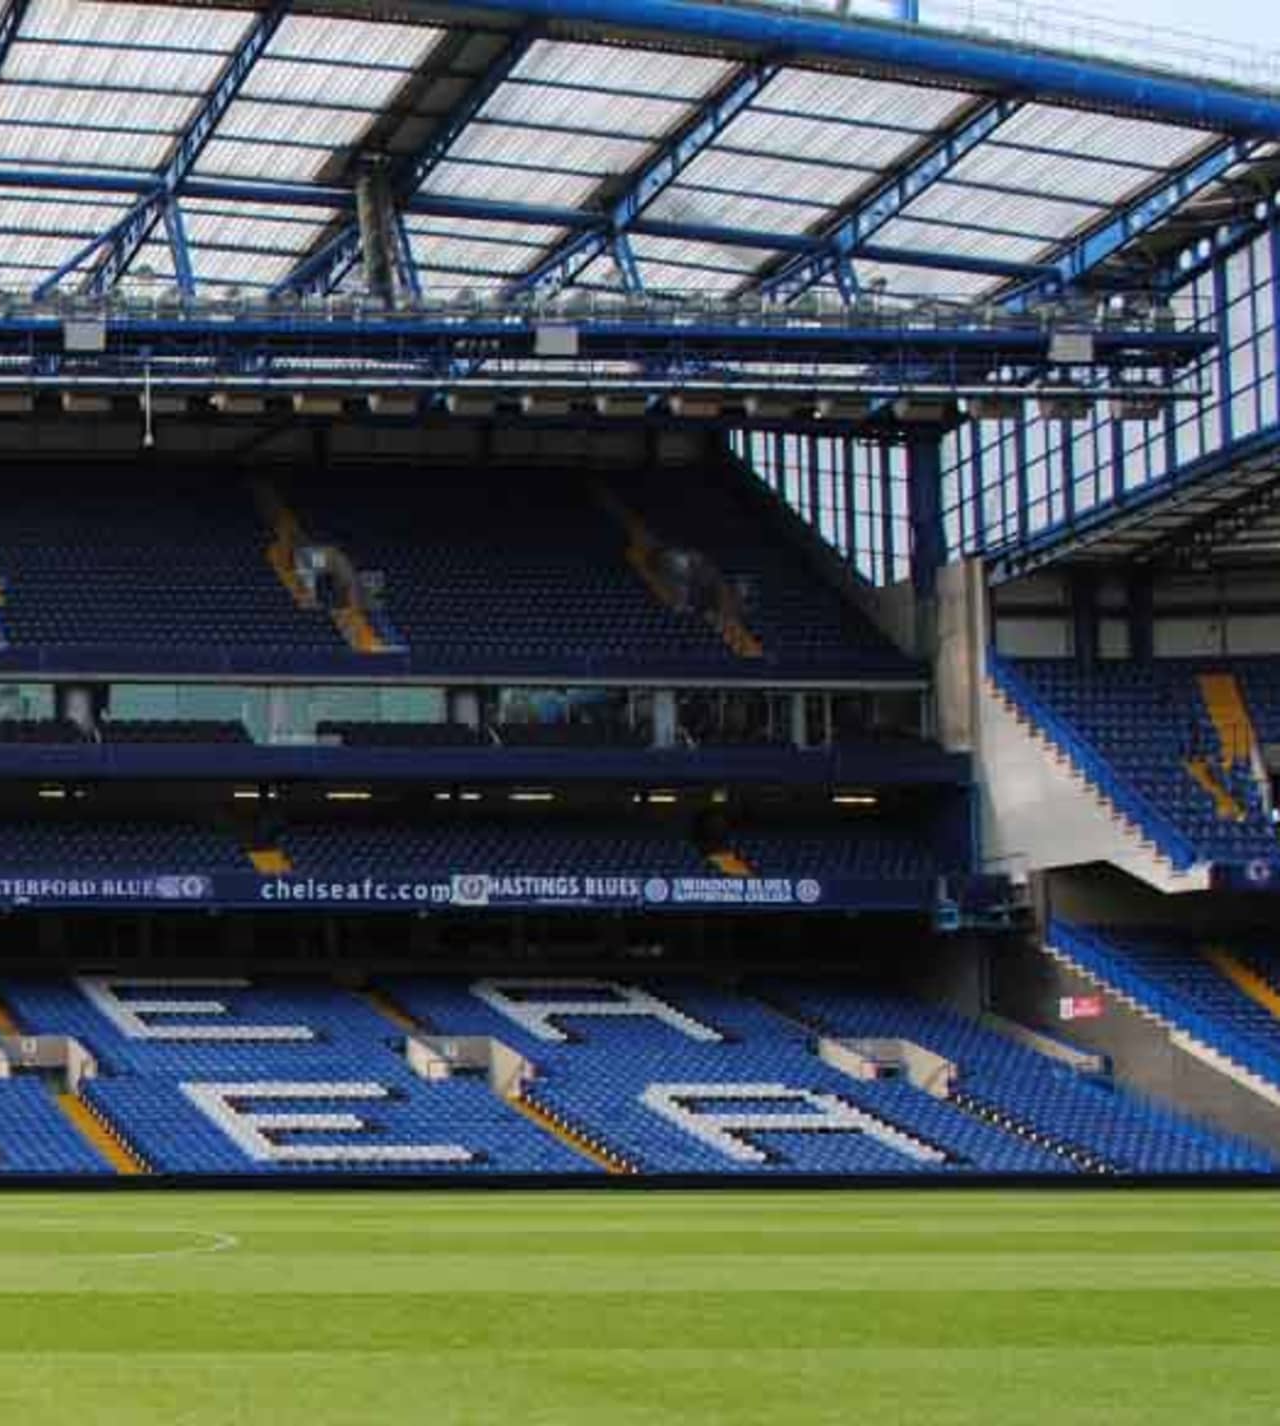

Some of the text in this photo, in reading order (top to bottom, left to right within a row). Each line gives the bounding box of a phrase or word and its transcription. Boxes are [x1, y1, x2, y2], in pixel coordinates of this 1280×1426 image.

[260, 879, 451, 900] chelseafc.com
[489, 876, 640, 897] HASTINGS BLUES
